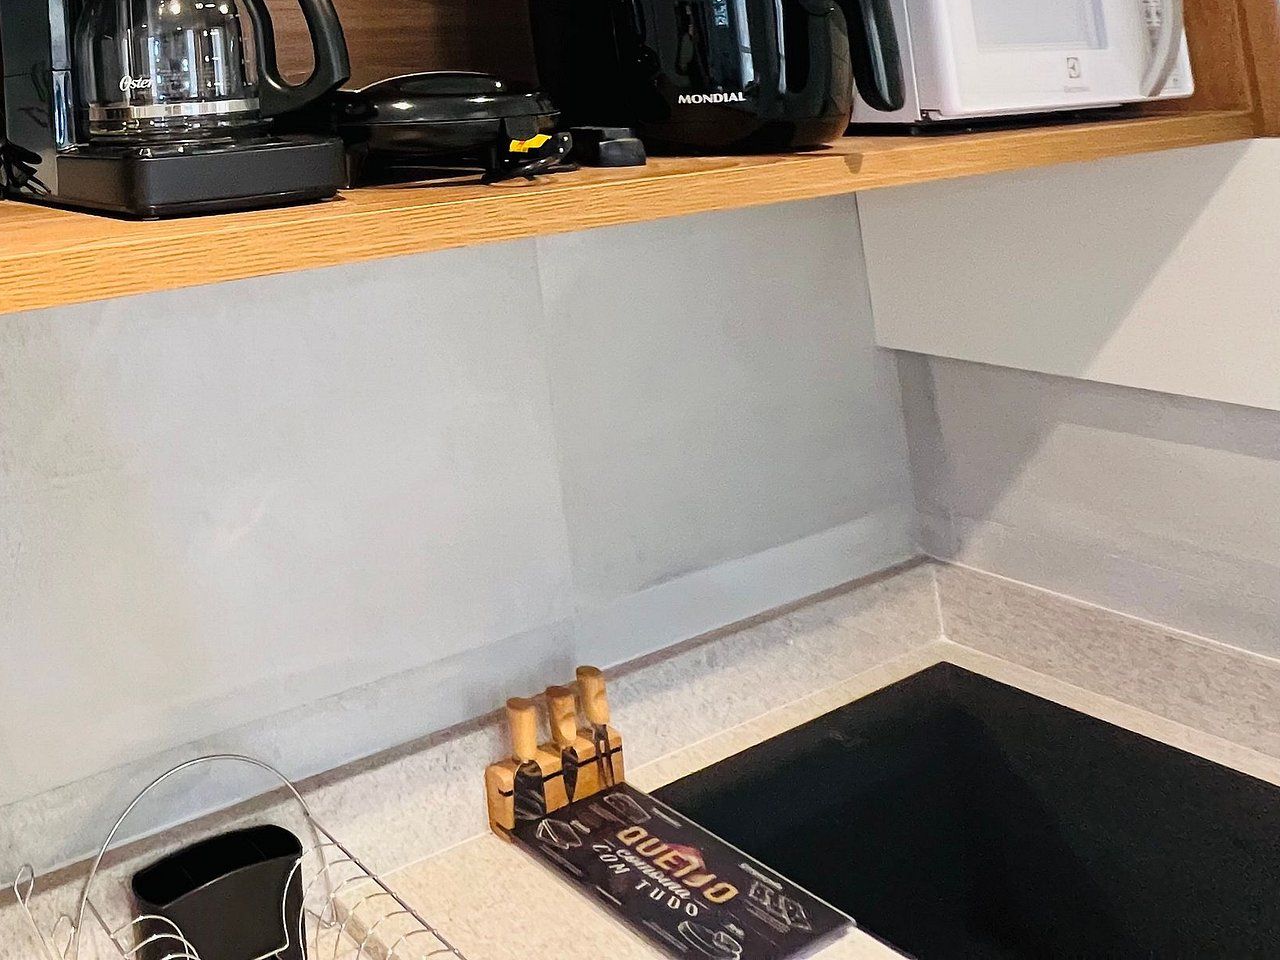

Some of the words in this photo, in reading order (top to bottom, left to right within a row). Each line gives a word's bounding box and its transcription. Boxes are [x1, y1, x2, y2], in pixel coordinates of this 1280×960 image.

[677, 91, 747, 105] MONDIAL
[592, 844, 631, 875] COM
[634, 879, 699, 918] TUDO
